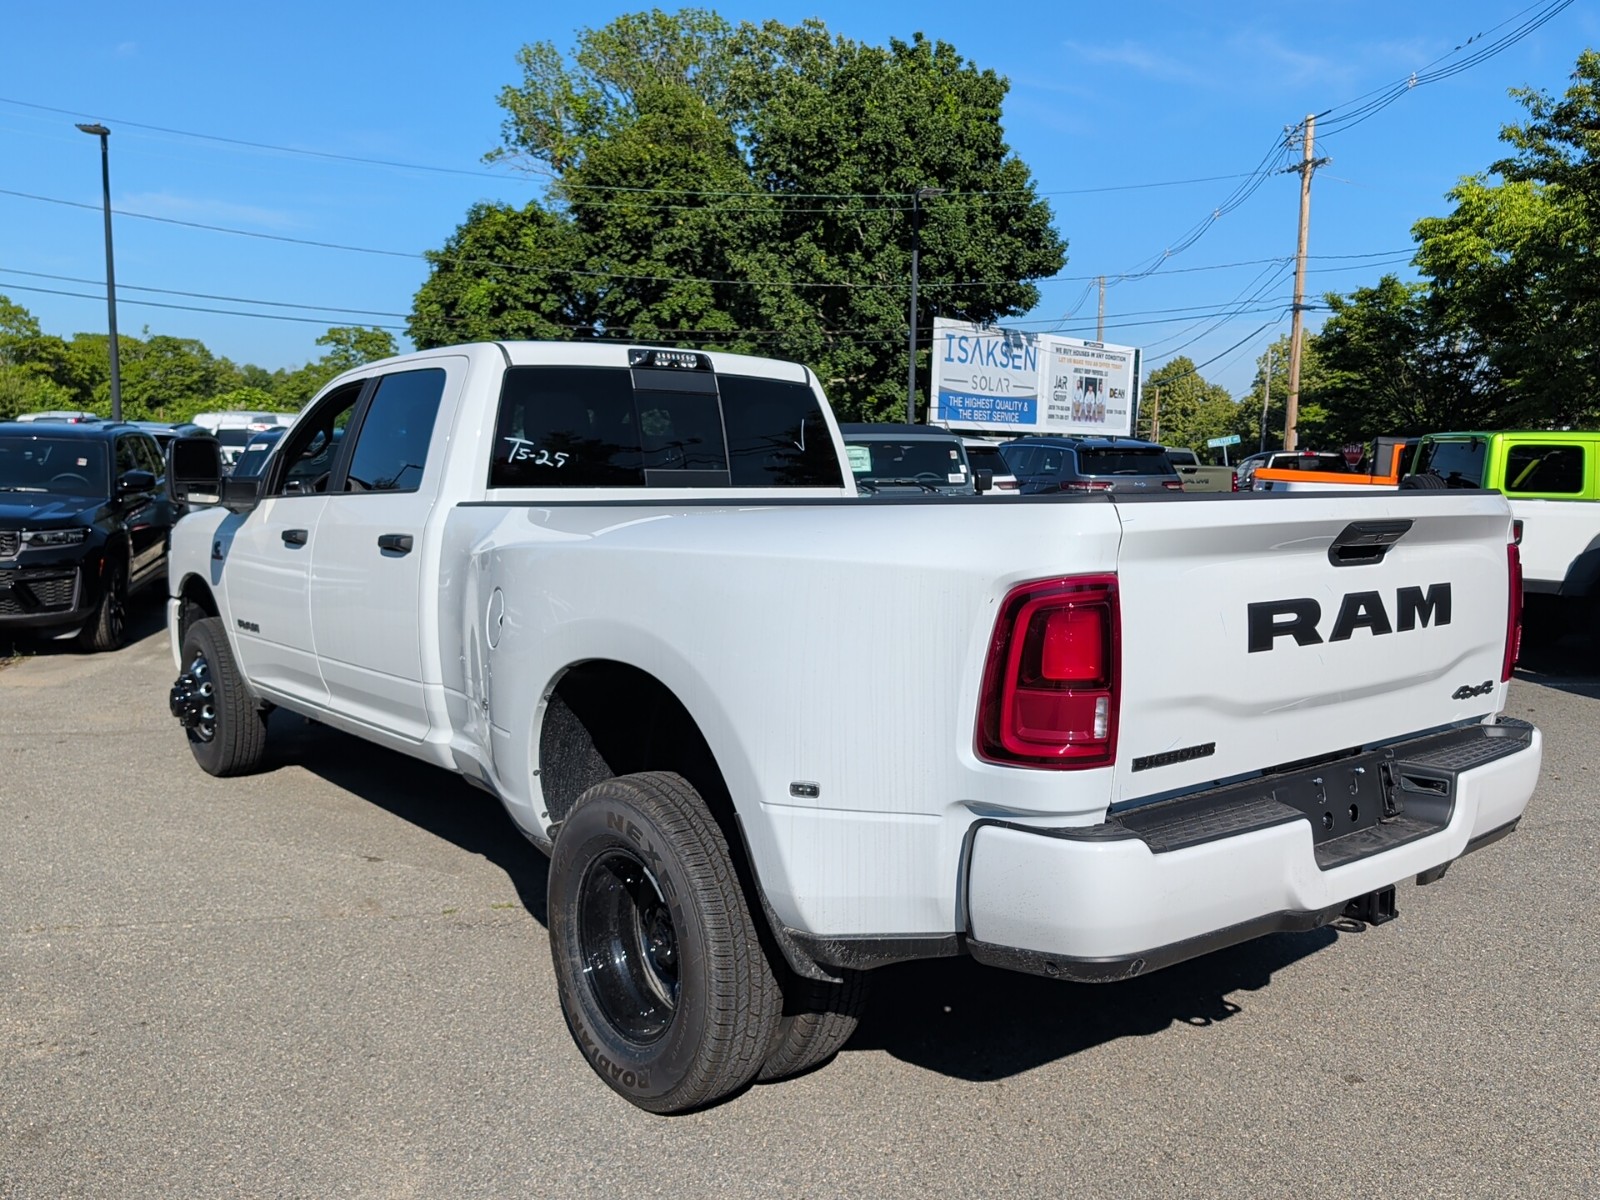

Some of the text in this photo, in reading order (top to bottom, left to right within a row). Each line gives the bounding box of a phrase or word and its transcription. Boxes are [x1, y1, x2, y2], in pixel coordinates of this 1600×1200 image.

[944, 333, 1037, 372] ISAKSEN
[971, 375, 1010, 393] SOLAR
[948, 396, 1029, 412] THE HIGHEST QUALITY &
[958, 409, 1020, 423] THE BEST SERVICE
[1247, 582, 1452, 653] RAM
